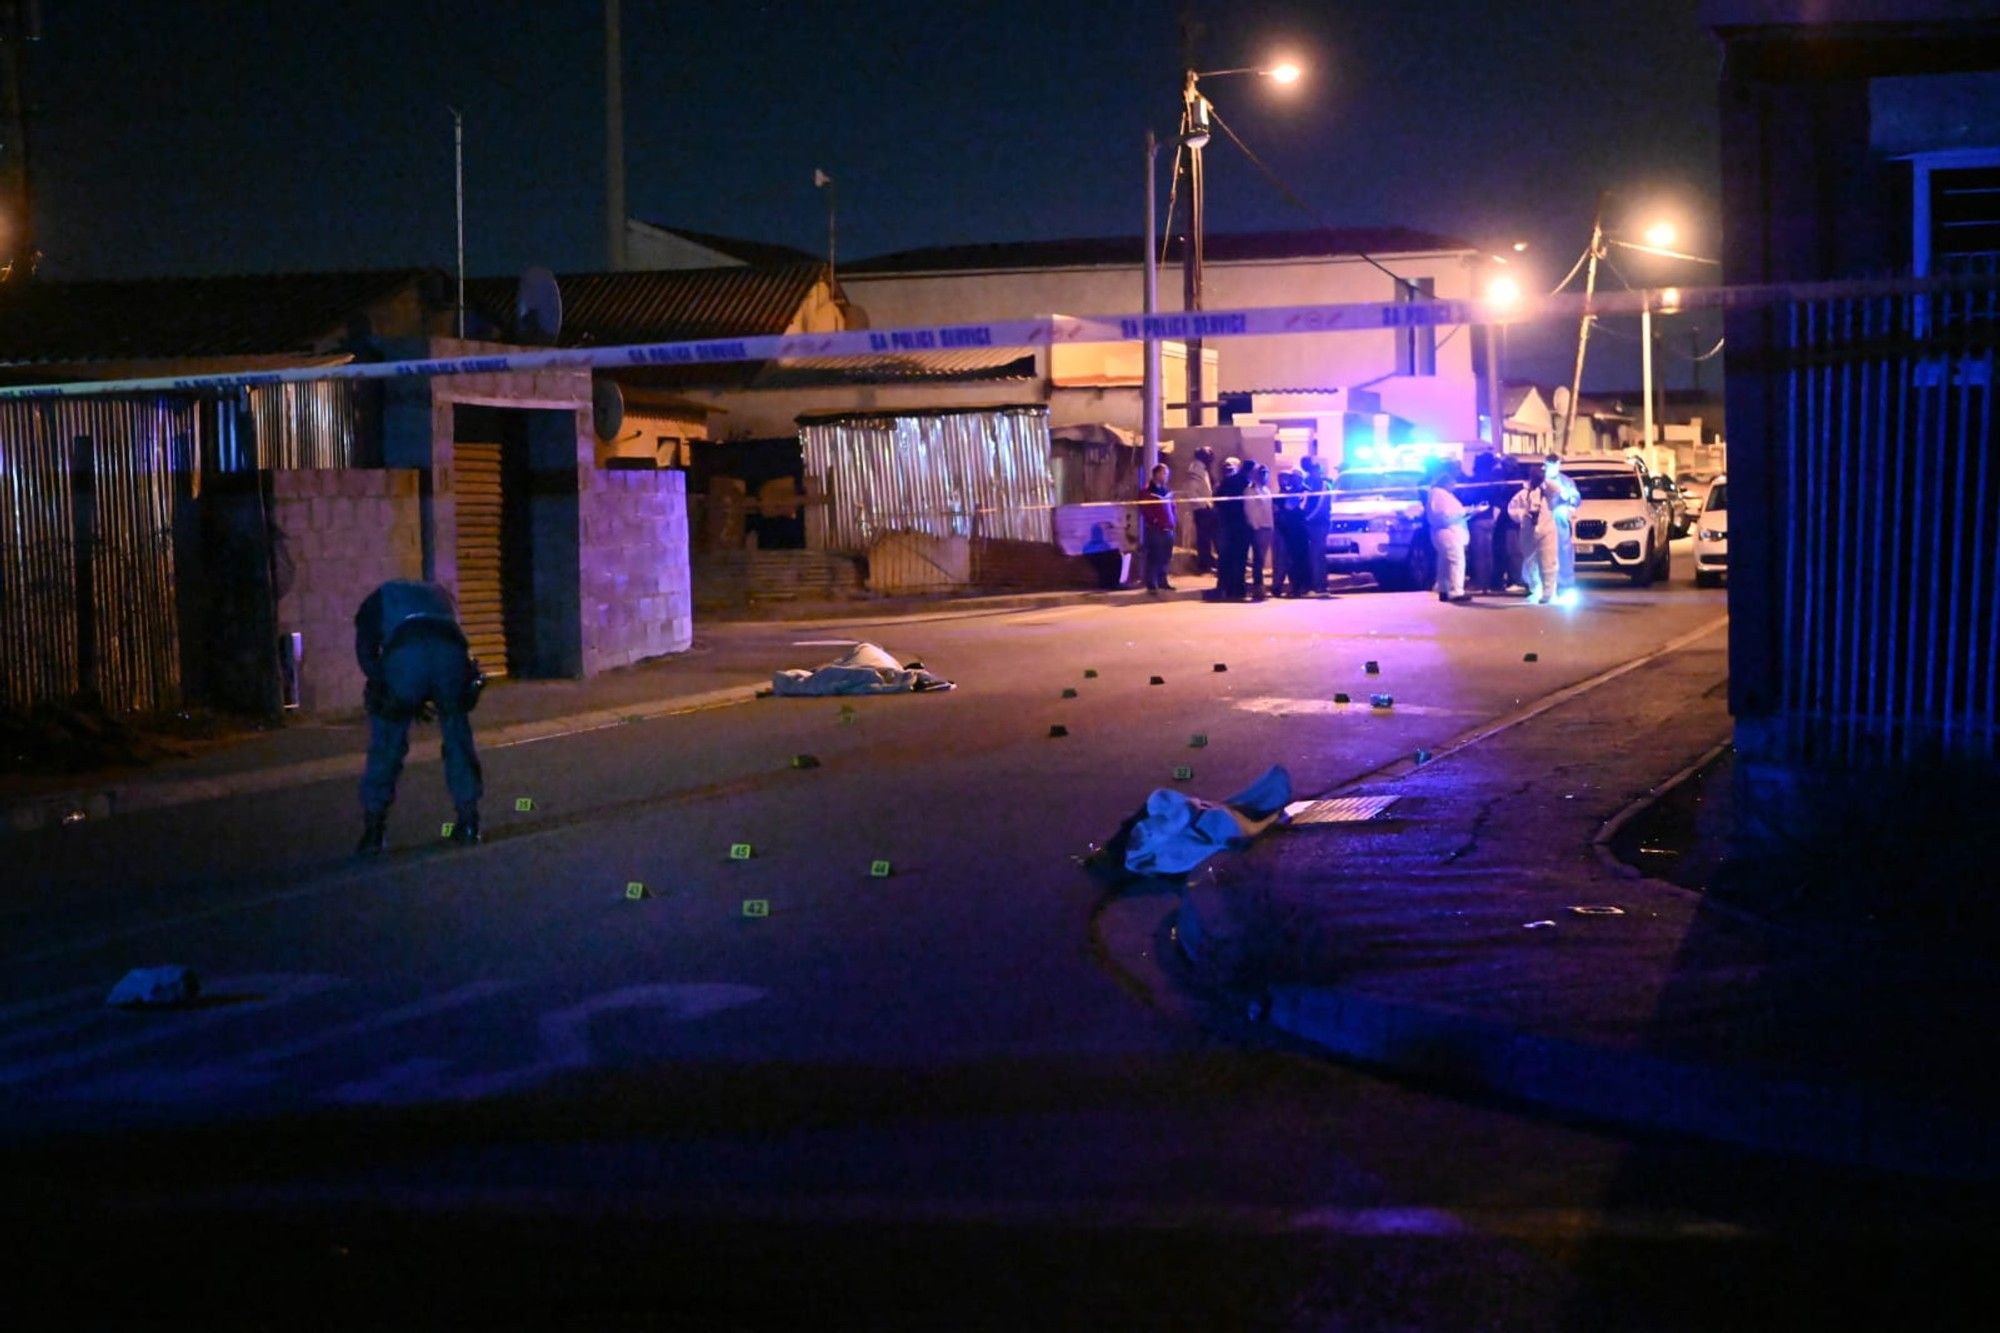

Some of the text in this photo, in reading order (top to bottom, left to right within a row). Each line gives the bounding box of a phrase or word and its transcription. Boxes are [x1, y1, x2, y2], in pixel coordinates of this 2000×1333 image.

[1121, 313, 1246, 339] SA POLICE SERVICE
[870, 326, 991, 351] SA POLICE SERVICE
[628, 341, 747, 363] SA POLICE SERVICE
[746, 902, 764, 914] 42
